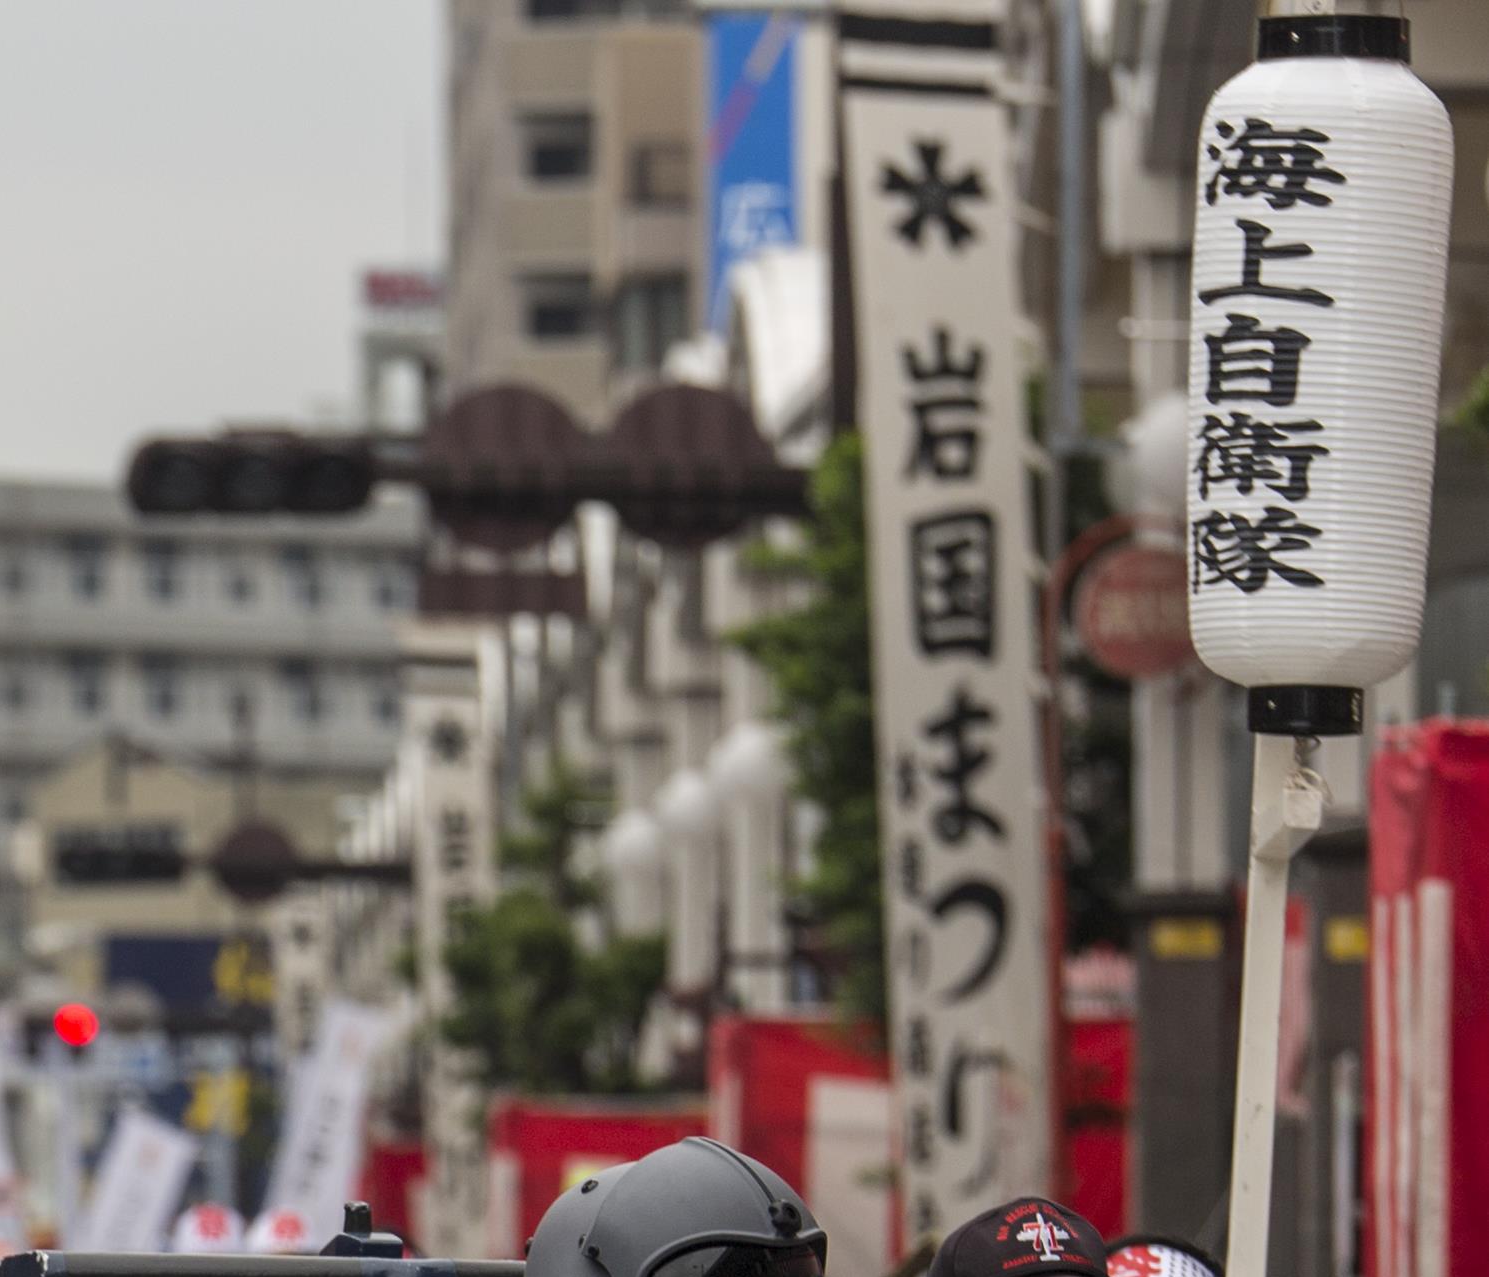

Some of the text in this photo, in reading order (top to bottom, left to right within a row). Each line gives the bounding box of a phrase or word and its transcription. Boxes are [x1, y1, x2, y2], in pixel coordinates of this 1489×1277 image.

[1191, 117, 1347, 595] 海上自衛隊
